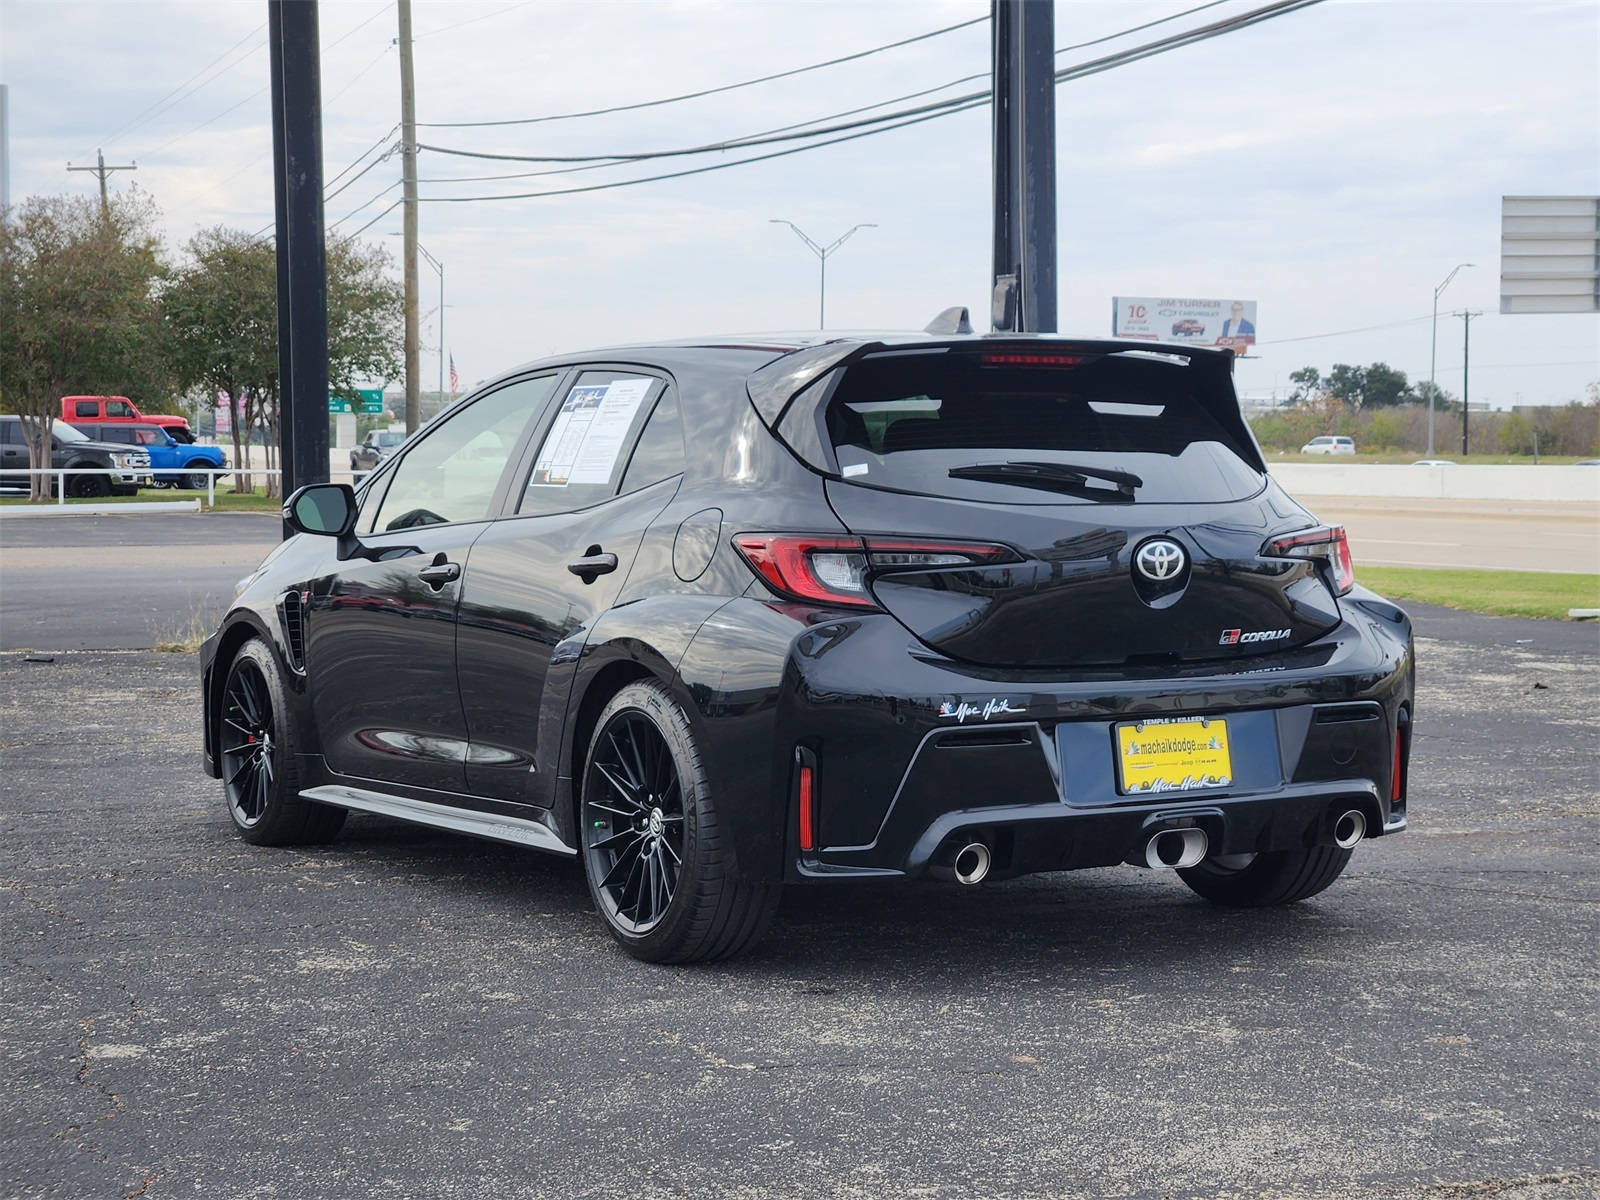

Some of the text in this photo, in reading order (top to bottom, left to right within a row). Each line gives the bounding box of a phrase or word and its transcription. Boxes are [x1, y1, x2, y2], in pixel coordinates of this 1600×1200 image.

[1157, 299, 1221, 308] JIM TURNER
[1240, 628, 1292, 643] COROLLA
[954, 697, 1018, 723] Mac Haik
[1142, 715, 1205, 726] TEMPLE KILLEEN
[1140, 737, 1208, 755] machaikdodge.com
[1149, 774, 1212, 793] Mac Haik
